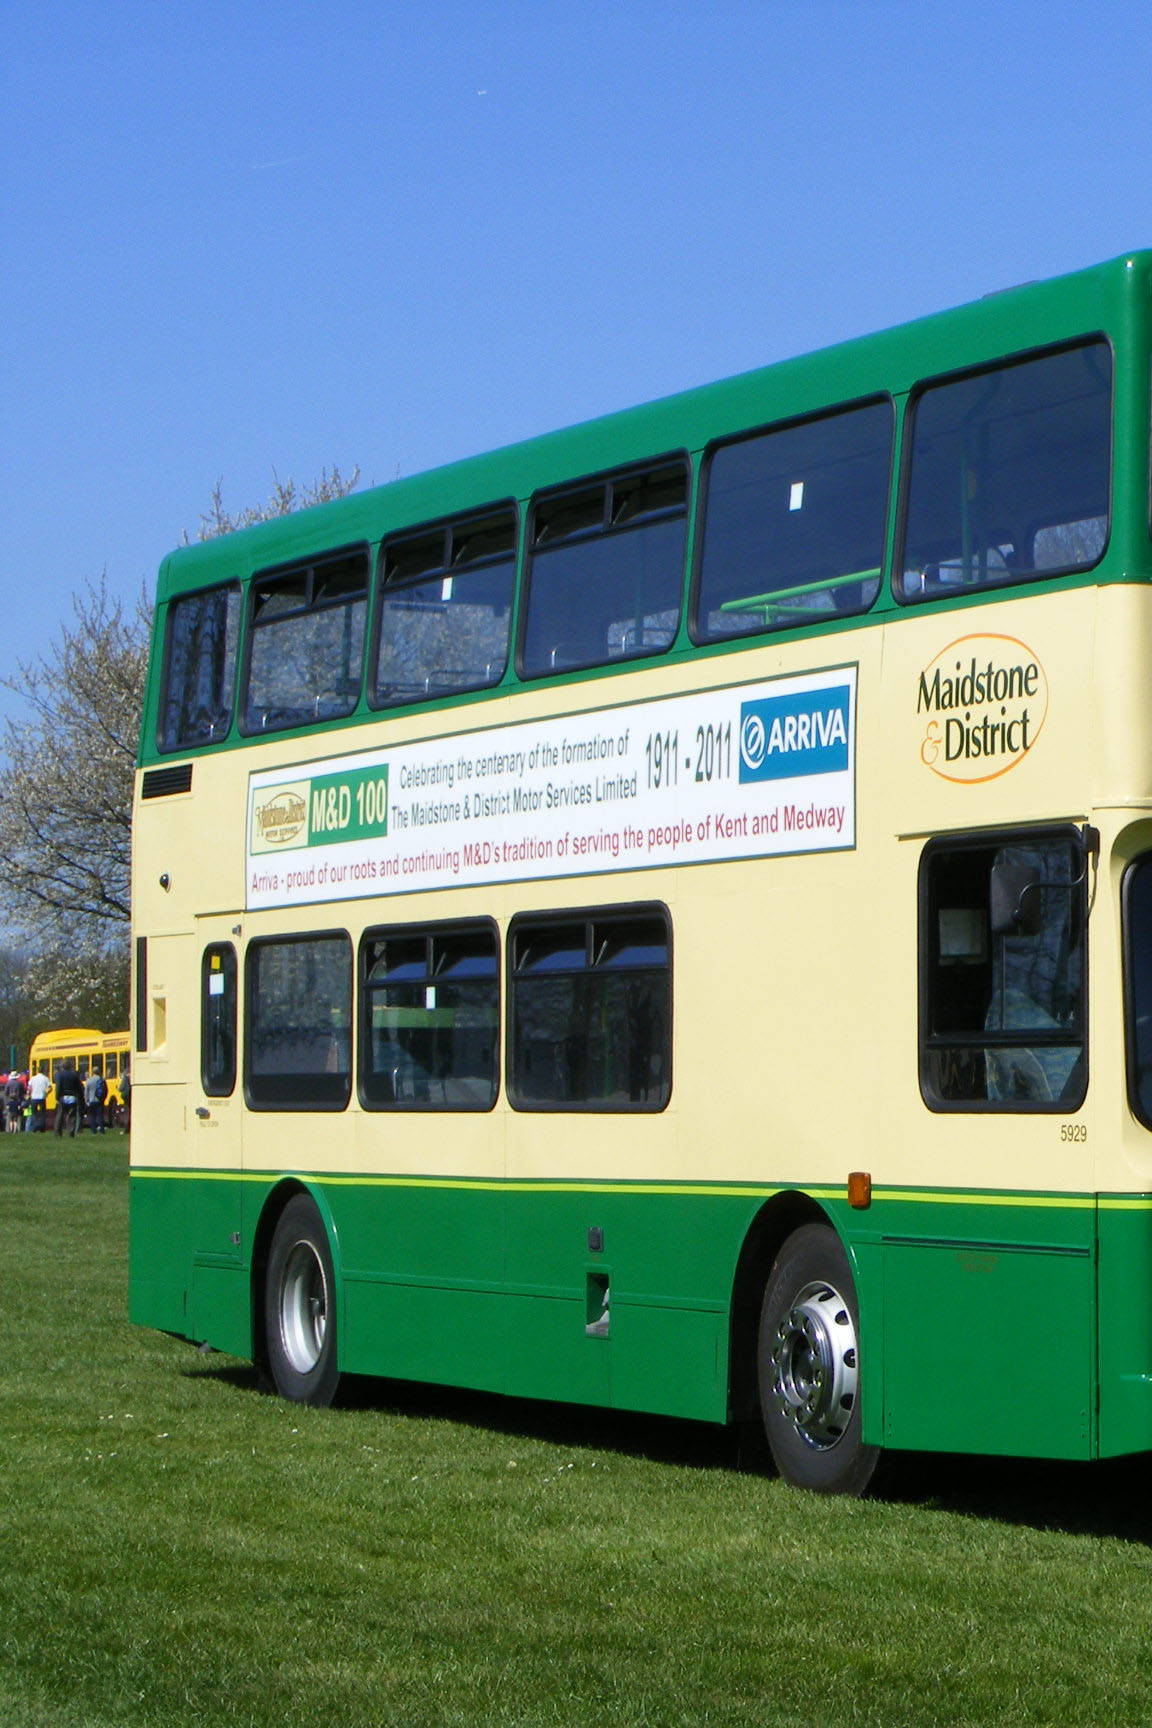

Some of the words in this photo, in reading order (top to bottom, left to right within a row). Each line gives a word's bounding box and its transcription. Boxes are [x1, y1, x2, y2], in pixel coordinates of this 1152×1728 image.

[917, 658, 1038, 714] Maidstone
[400, 760, 454, 789] Celebrating
[457, 755, 473, 780] the
[476, 752, 525, 778] centenary
[529, 743, 540, 769] of
[542, 741, 558, 769] the
[562, 733, 614, 765] formation
[617, 728, 629, 756] of
[646, 729, 678, 789] 1911
[694, 720, 731, 782] 2011
[767, 708, 847, 755] ARRIVA
[920, 720, 943, 765] &
[945, 706, 1031, 761] District
[311, 785, 351, 833] M&D
[356, 779, 386, 826] 100
[392, 805, 409, 830] The
[411, 800, 460, 828] Maidstone
[463, 795, 471, 820] &
[474, 789, 511, 818] District
[513, 786, 543, 813] Motor
[546, 780, 592, 809] Services
[595, 770, 637, 803] Limited
[252, 870, 278, 893] Arriva
[287, 865, 315, 893] proud
[318, 862, 328, 885] of
[331, 863, 347, 883] our
[351, 859, 376, 880] roots
[380, 853, 399, 877] and
[402, 847, 460, 875] continuing
[463, 840, 500, 868] M&D's
[502, 836, 553, 863] tradition
[557, 832, 569, 857] of
[572, 828, 619, 857] serving
[624, 824, 643, 850] the
[648, 818, 692, 852] people
[697, 814, 711, 841] of
[715, 813, 748, 839] Kent
[752, 806, 778, 835] and
[784, 802, 845, 833] Medway
[1060, 1124, 1087, 1142] 5929
